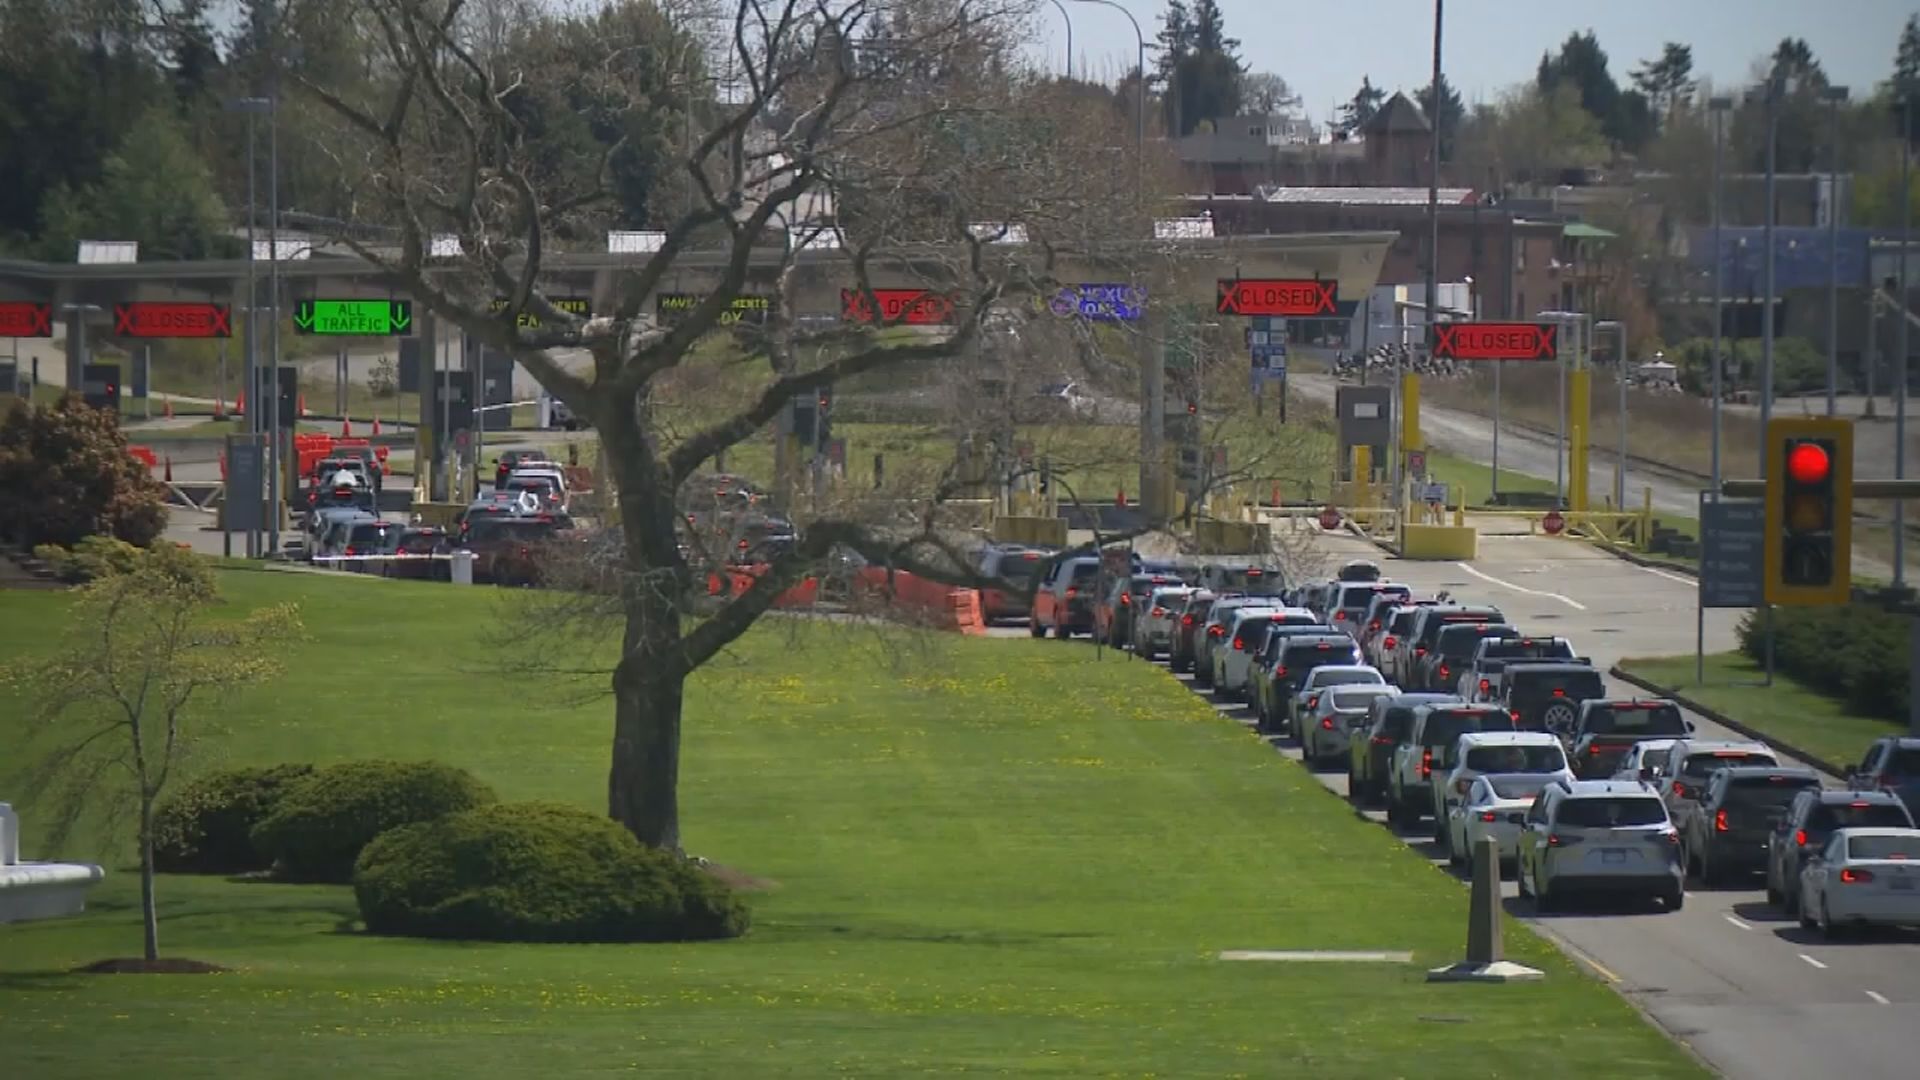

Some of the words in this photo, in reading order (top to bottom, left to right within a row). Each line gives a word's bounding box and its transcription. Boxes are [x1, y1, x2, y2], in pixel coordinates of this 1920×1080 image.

[1241, 288, 1314, 306] CLOSED
[337, 303, 366, 316] ALL
[322, 317, 383, 331] TRAFFIC
[1458, 333, 1533, 350] CLOSED
